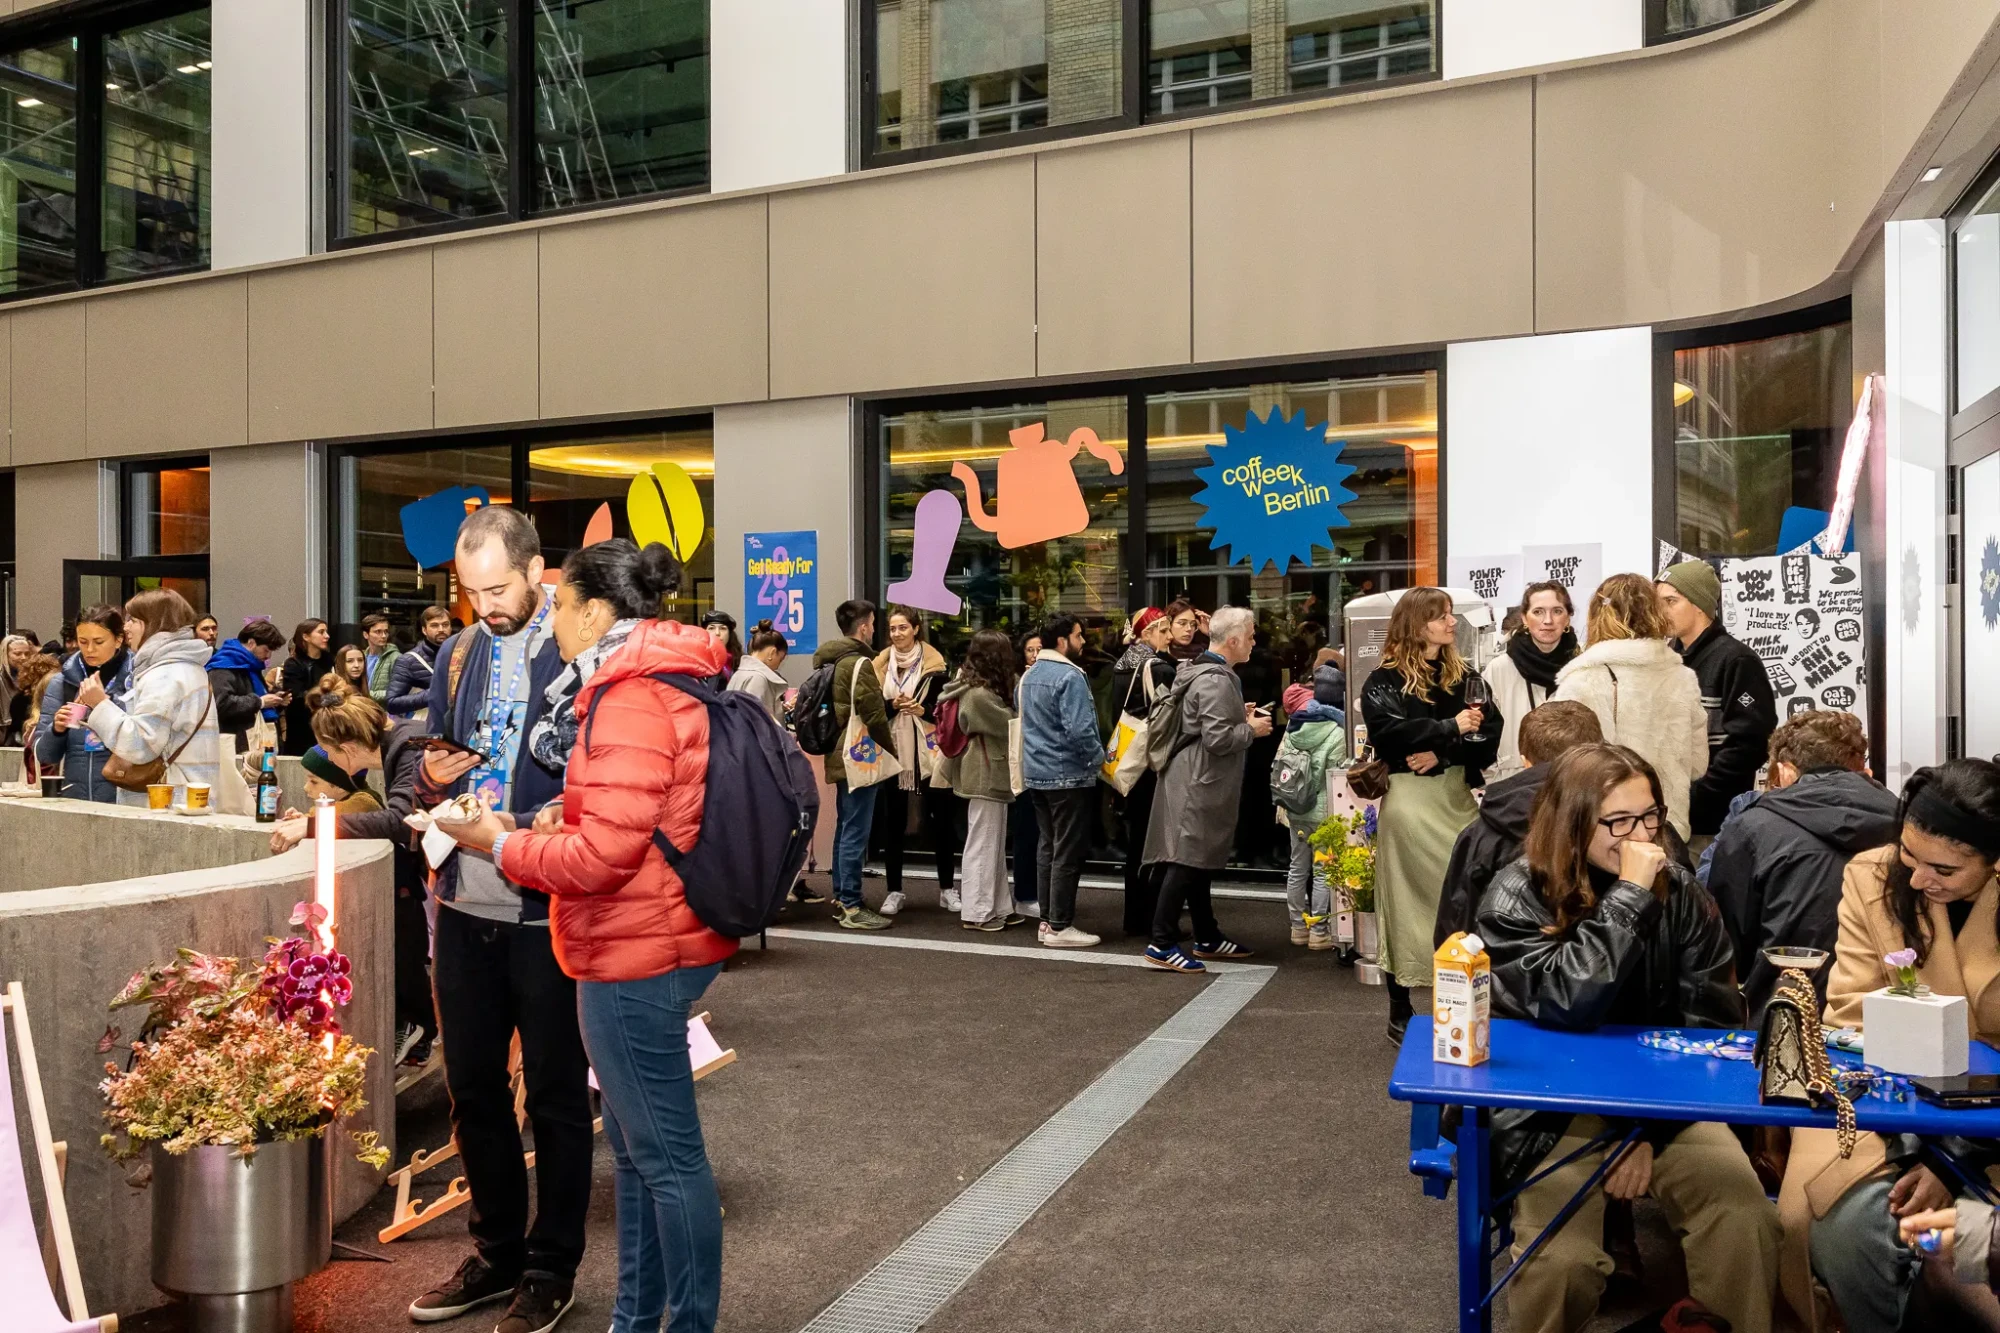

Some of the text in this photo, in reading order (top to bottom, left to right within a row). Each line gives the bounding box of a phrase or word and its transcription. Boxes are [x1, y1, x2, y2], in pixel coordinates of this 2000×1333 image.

[1263, 483, 1330, 516] Berlin
[748, 556, 813, 578] Get Ready For
[1545, 556, 1582, 571] POWER-
[1787, 557, 1804, 566] WE
[1469, 567, 1505, 581] POWER-
[1550, 568, 1574, 579] ED BY
[1737, 569, 1773, 583] WOW
[1787, 574, 1805, 585] LIE
[1474, 578, 1498, 590] ED BY
[1745, 580, 1765, 593] NO
[1474, 587, 1499, 599] ATLY
[1737, 588, 1775, 603] COW!
[1818, 590, 1833, 599] We
[1817, 598, 1828, 607] to
[1829, 597, 1839, 606] be
[1755, 607, 1774, 619] love
[1775, 612, 1790, 623] my
[1753, 634, 1781, 648] MILK
[1819, 634, 1831, 645] DO
[1801, 644, 1833, 672] ANI
[1804, 651, 1853, 689] MALS
[1823, 687, 1846, 698] oat
[1827, 695, 1852, 706] me!
